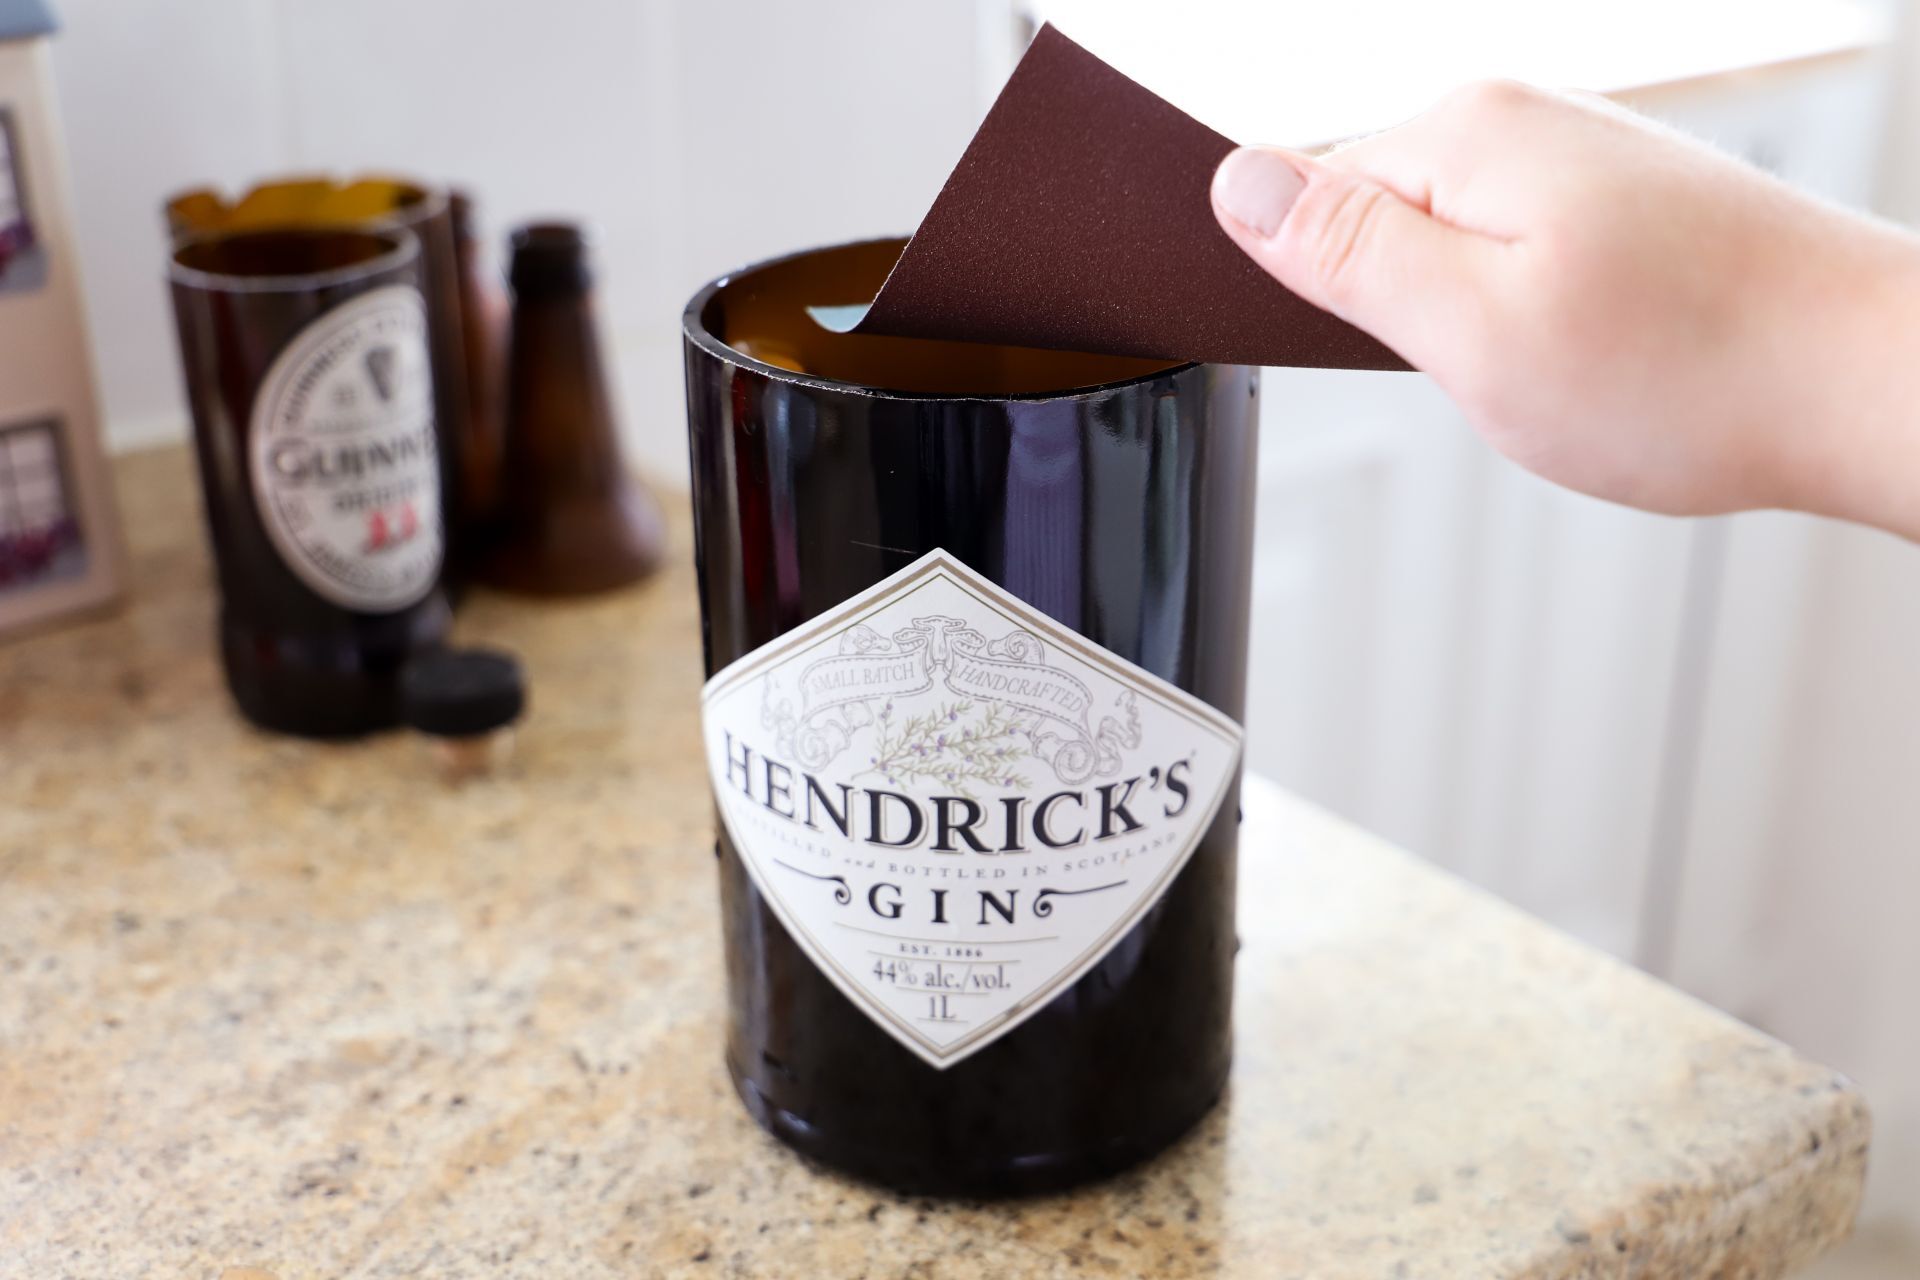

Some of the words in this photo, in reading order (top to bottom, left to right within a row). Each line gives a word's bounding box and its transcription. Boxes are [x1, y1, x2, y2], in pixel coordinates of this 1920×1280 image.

[811, 668, 859, 696] SMALL
[863, 661, 915, 687] BATCH
[957, 663, 1086, 713] HANDCRAFTED
[724, 729, 1192, 855] HENDRICK'S
[738, 804, 831, 859] STILLED
[844, 857, 877, 870] and
[888, 861, 1007, 879] BOTTLED
[1022, 863, 1048, 879] IN
[1063, 831, 1177, 873] SCOTLAND
[867, 882, 1020, 925] GIN
[899, 942, 937, 955] EST.
[872, 958, 918, 985] 44%
[924, 962, 1012, 994] alc./vol.
[929, 994, 957, 1020] 1L
